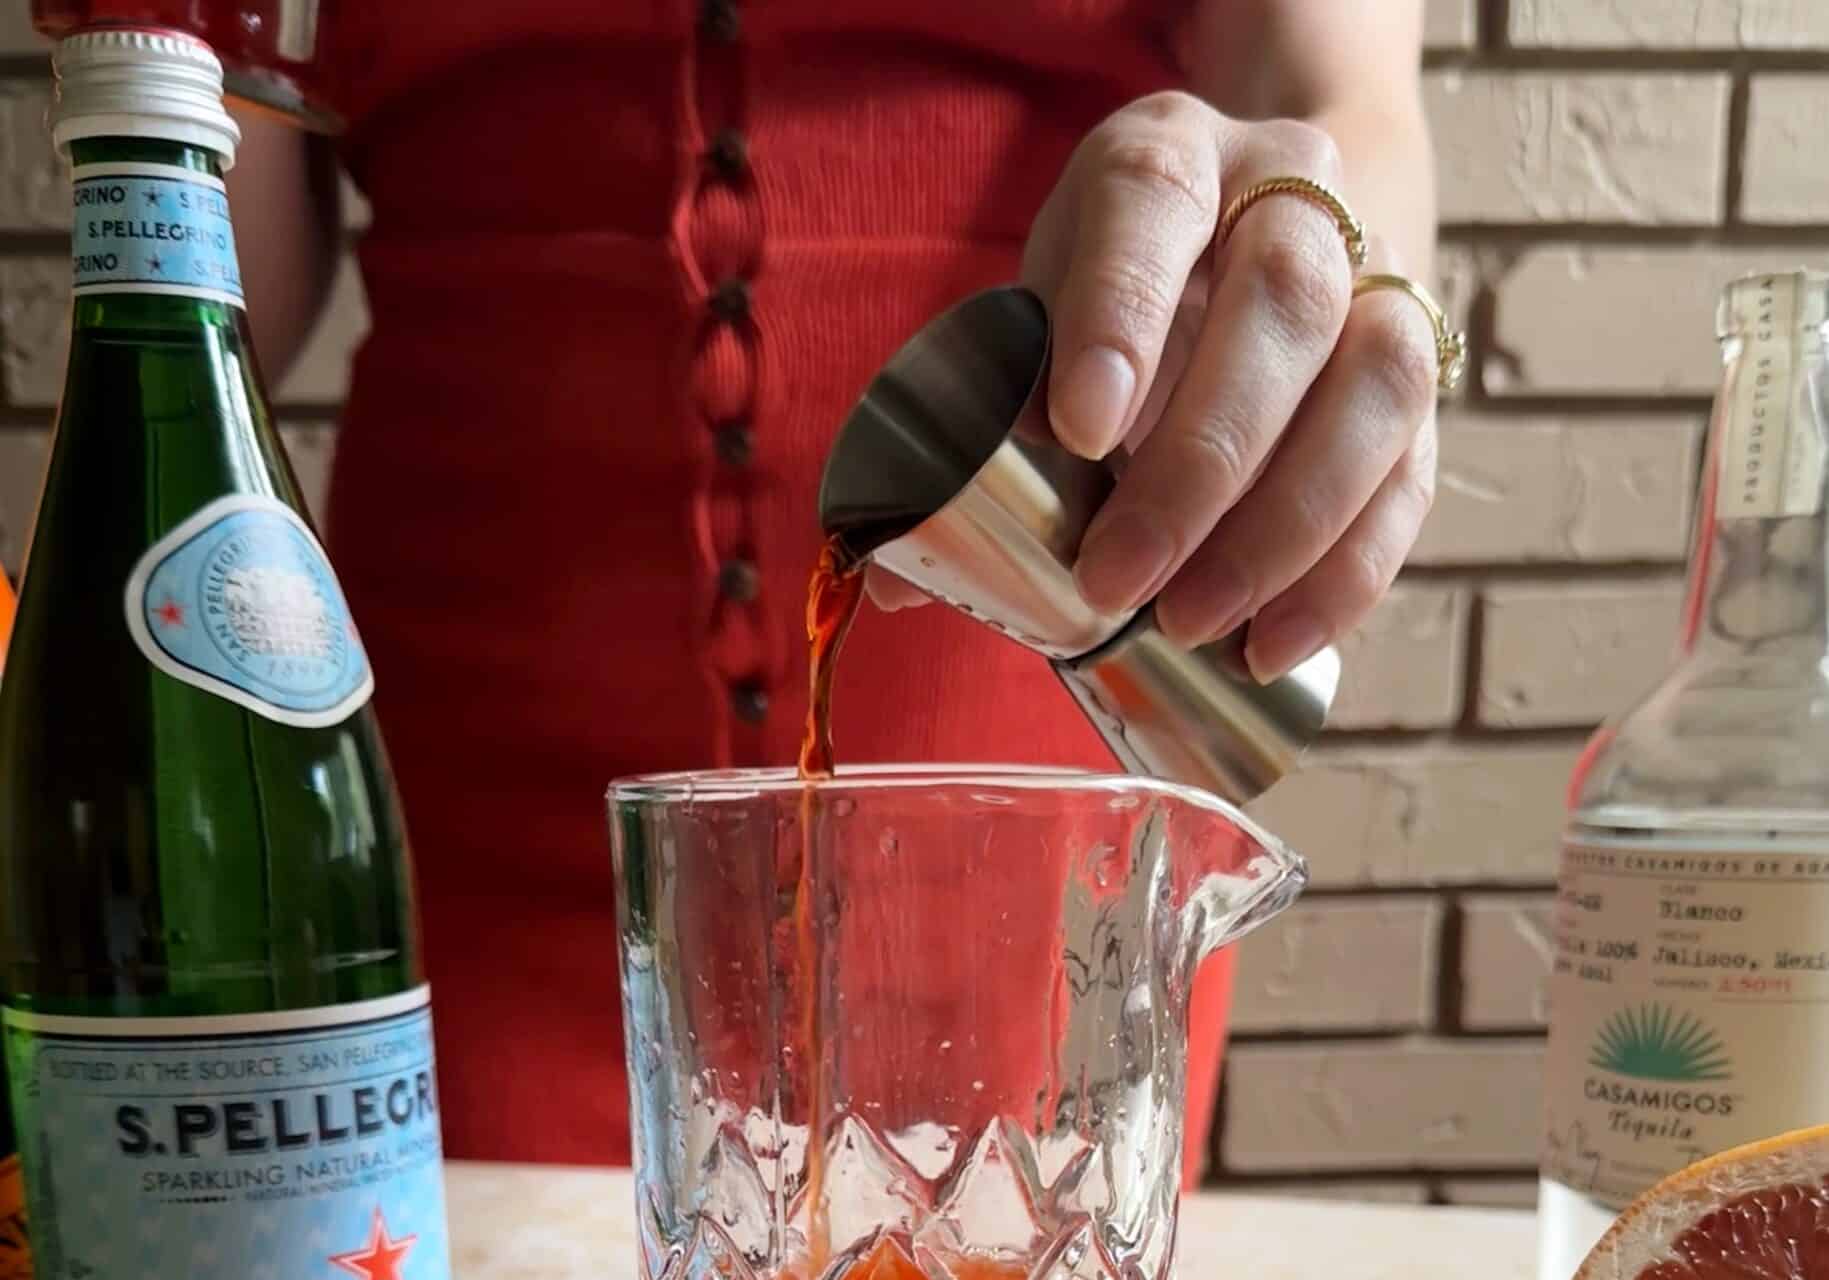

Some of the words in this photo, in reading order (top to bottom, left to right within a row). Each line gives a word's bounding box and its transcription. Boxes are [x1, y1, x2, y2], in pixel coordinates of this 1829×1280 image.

[1659, 900, 1744, 922] Blanco
[300, 1049, 341, 1074] SAN
[1584, 1077, 1734, 1116] CASAMIGOS
[1607, 1108, 1694, 1142] Tequila
[142, 1163, 286, 1193] SPARKLING
[296, 1147, 392, 1181] NATURAL
